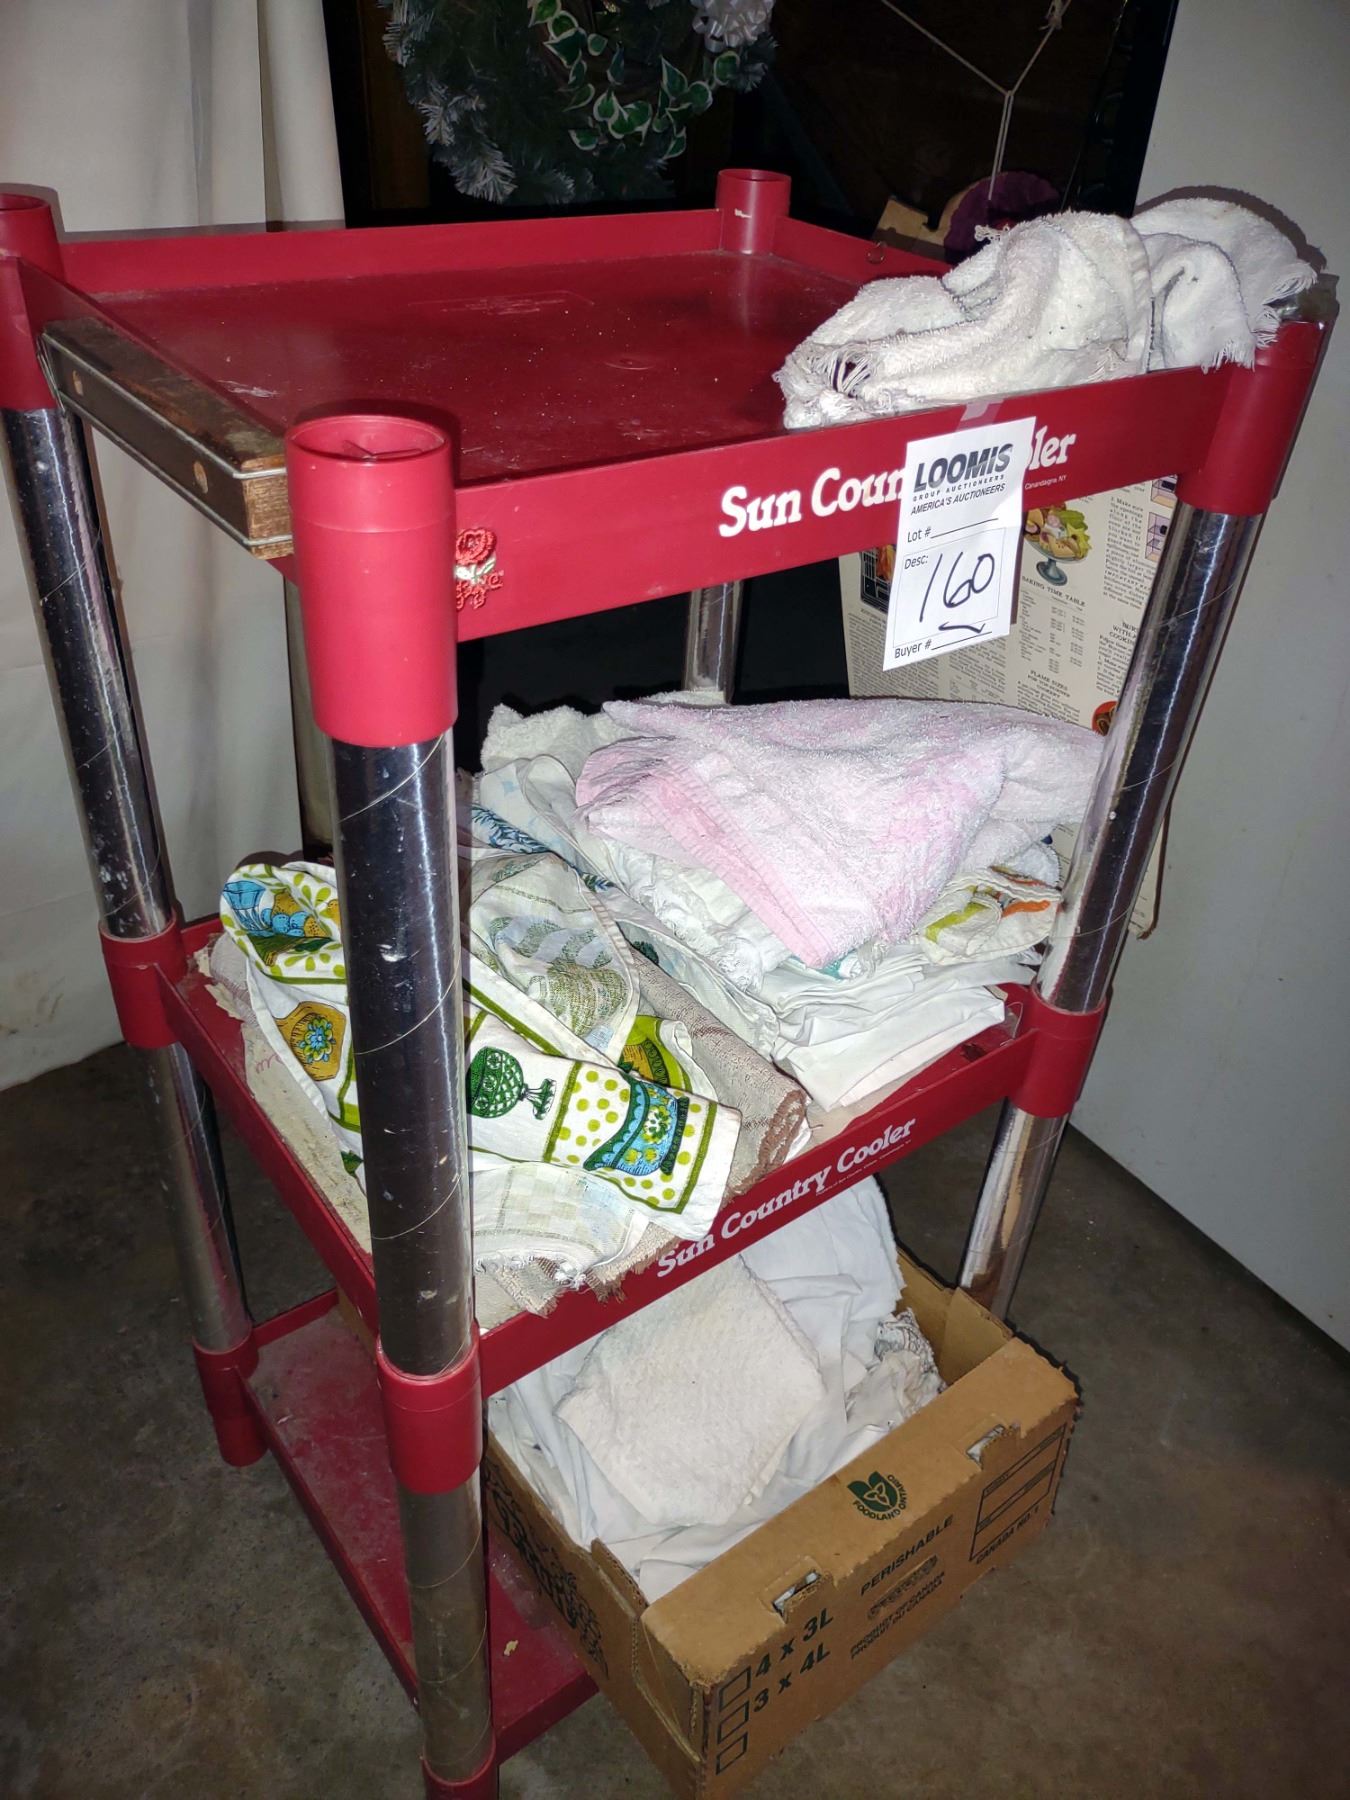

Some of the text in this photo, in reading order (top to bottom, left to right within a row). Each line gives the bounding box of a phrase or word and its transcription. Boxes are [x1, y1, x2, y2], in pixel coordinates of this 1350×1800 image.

[719, 426, 1077, 538] Sun Coun ler
[913, 474, 1005, 502] GROUP AUCTIONEERS
[914, 443, 1014, 493] LOOMIS
[911, 483, 1006, 516] AMERICA'S AUCTIONEERS
[907, 527, 932, 543] Lot #
[904, 554, 929, 570] Desc:
[919, 551, 995, 623] 160
[894, 639, 932, 658] Buyer #
[657, 1232, 715, 1277] Sun
[722, 1165, 832, 1239] Country
[837, 1118, 916, 1173] Cooler
[852, 1499, 901, 1520] FOODLAND
[860, 1514, 954, 1596] PERISHABLE
[755, 1653, 771, 1677] 4
[803, 1608, 833, 1641] 3L
[753, 1688, 769, 1712] 3
[800, 1642, 830, 1674] 4L
